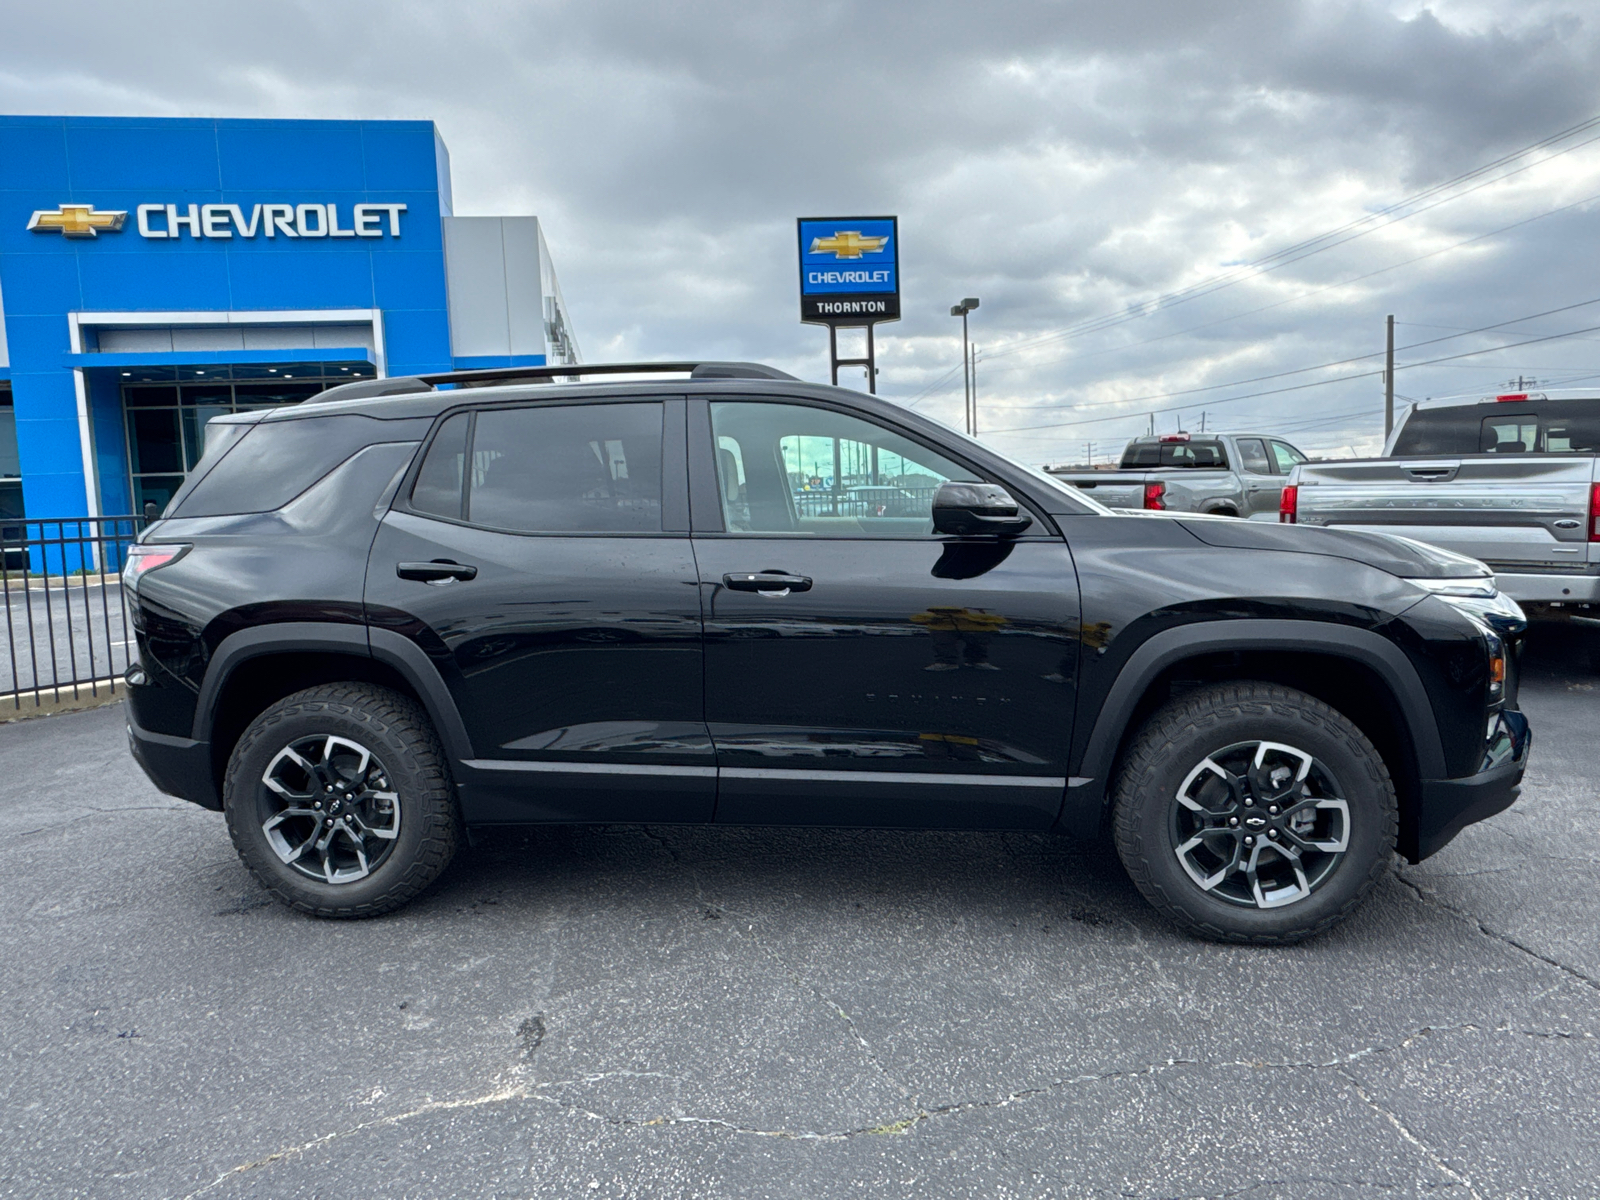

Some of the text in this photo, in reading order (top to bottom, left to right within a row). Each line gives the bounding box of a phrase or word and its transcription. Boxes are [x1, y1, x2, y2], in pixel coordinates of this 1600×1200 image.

[137, 203, 407, 238] CHEVROLET
[809, 271, 890, 283] CHEVROLET
[817, 301, 886, 313] THORNTON
